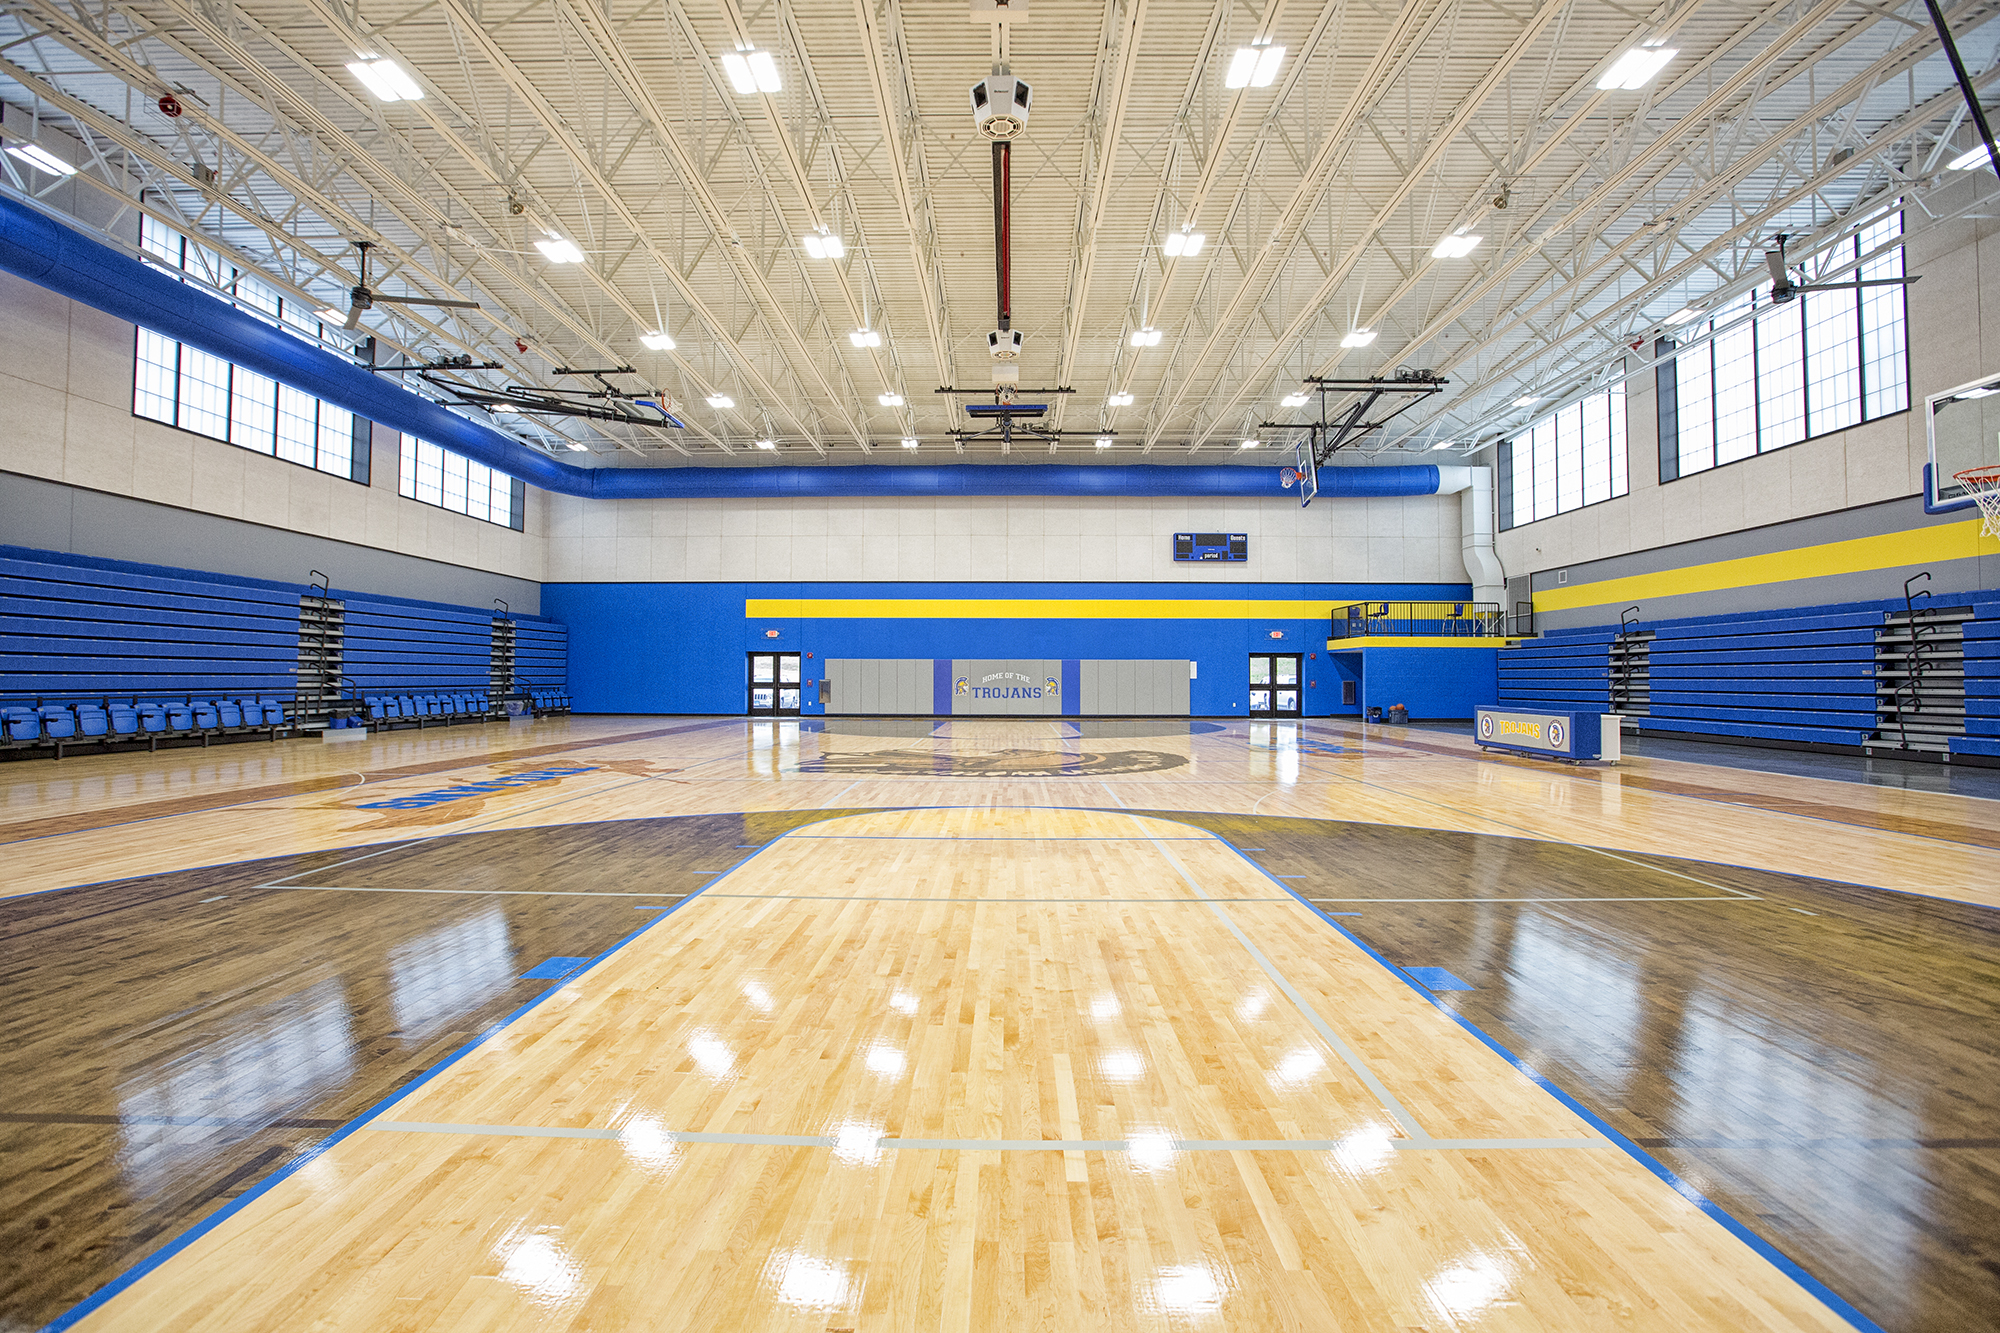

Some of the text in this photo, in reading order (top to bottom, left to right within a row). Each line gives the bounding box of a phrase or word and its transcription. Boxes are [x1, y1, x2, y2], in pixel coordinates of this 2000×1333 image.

[982, 672, 1004, 684] HOME
[1015, 673, 1031, 684] THE
[972, 687, 1042, 699] TROJANS
[1500, 720, 1540, 739] TROJANS
